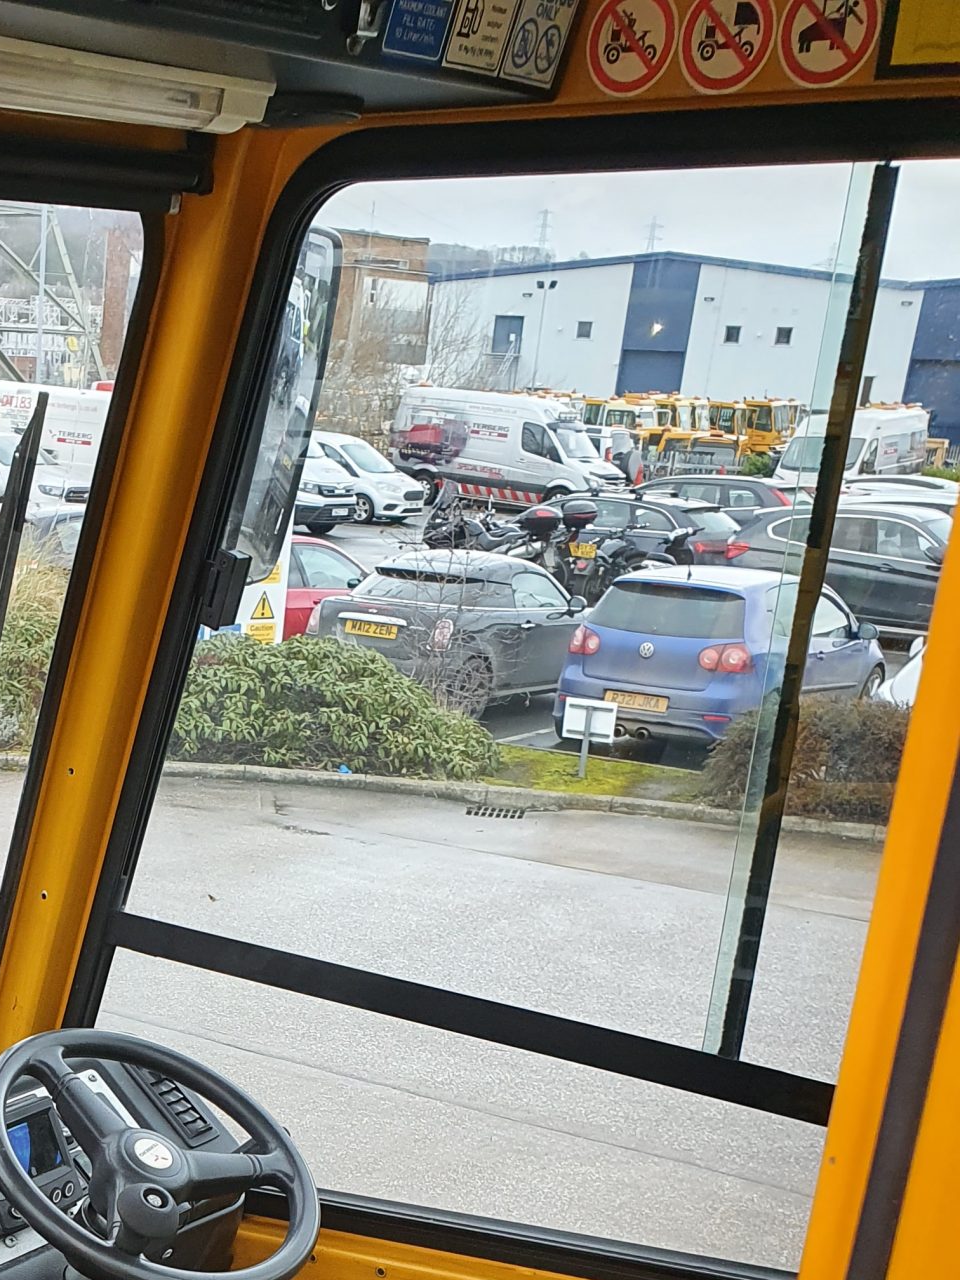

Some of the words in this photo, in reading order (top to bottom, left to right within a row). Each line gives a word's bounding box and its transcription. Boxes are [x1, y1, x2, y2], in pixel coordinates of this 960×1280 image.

[536, 3, 560, 20] ONLY
[402, 14, 415, 27] FILL
[373, 624, 393, 636] ZEN
